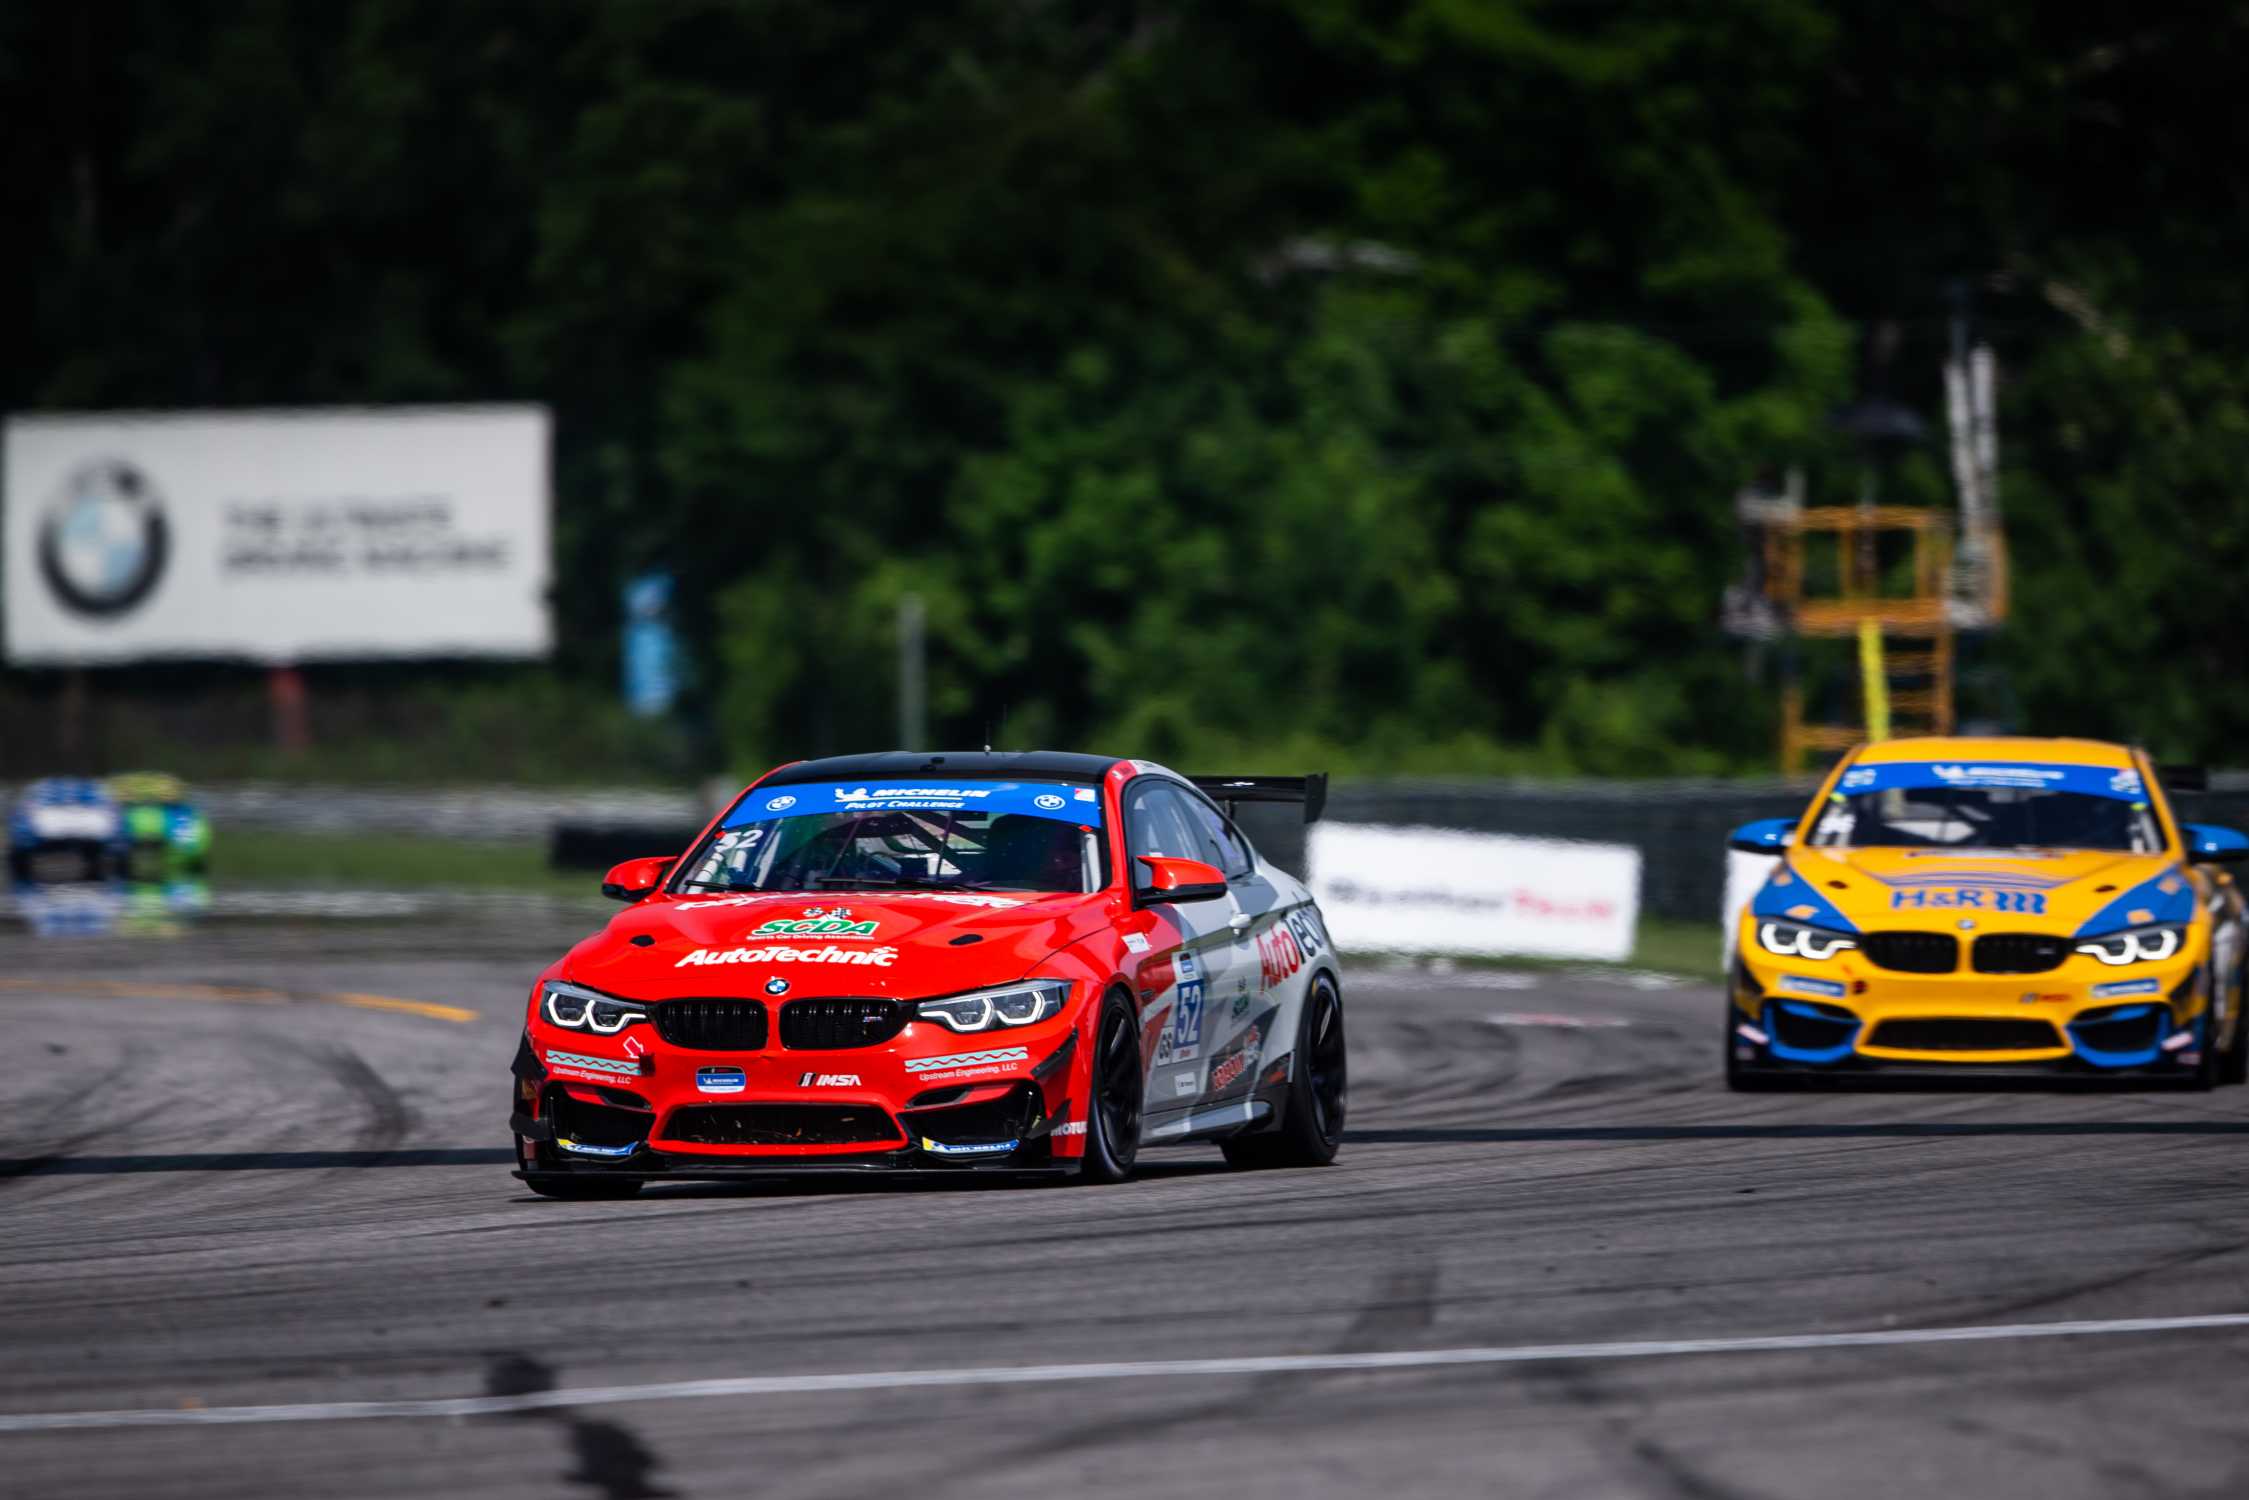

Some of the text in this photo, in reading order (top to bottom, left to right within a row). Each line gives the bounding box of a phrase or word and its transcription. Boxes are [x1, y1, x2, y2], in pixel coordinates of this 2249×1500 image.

[872, 788, 991, 798] MICHELIN
[845, 800, 966, 810] PILOT CHALLENGE
[714, 829, 764, 853] 52
[1892, 889, 1984, 908] H&R
[752, 919, 880, 935] SCDA
[675, 946, 899, 967] AutoTechnic
[1178, 984, 1202, 1043] 52
[1002, 1062, 1018, 1072] LLC
[816, 1073, 862, 1087] IMSA
